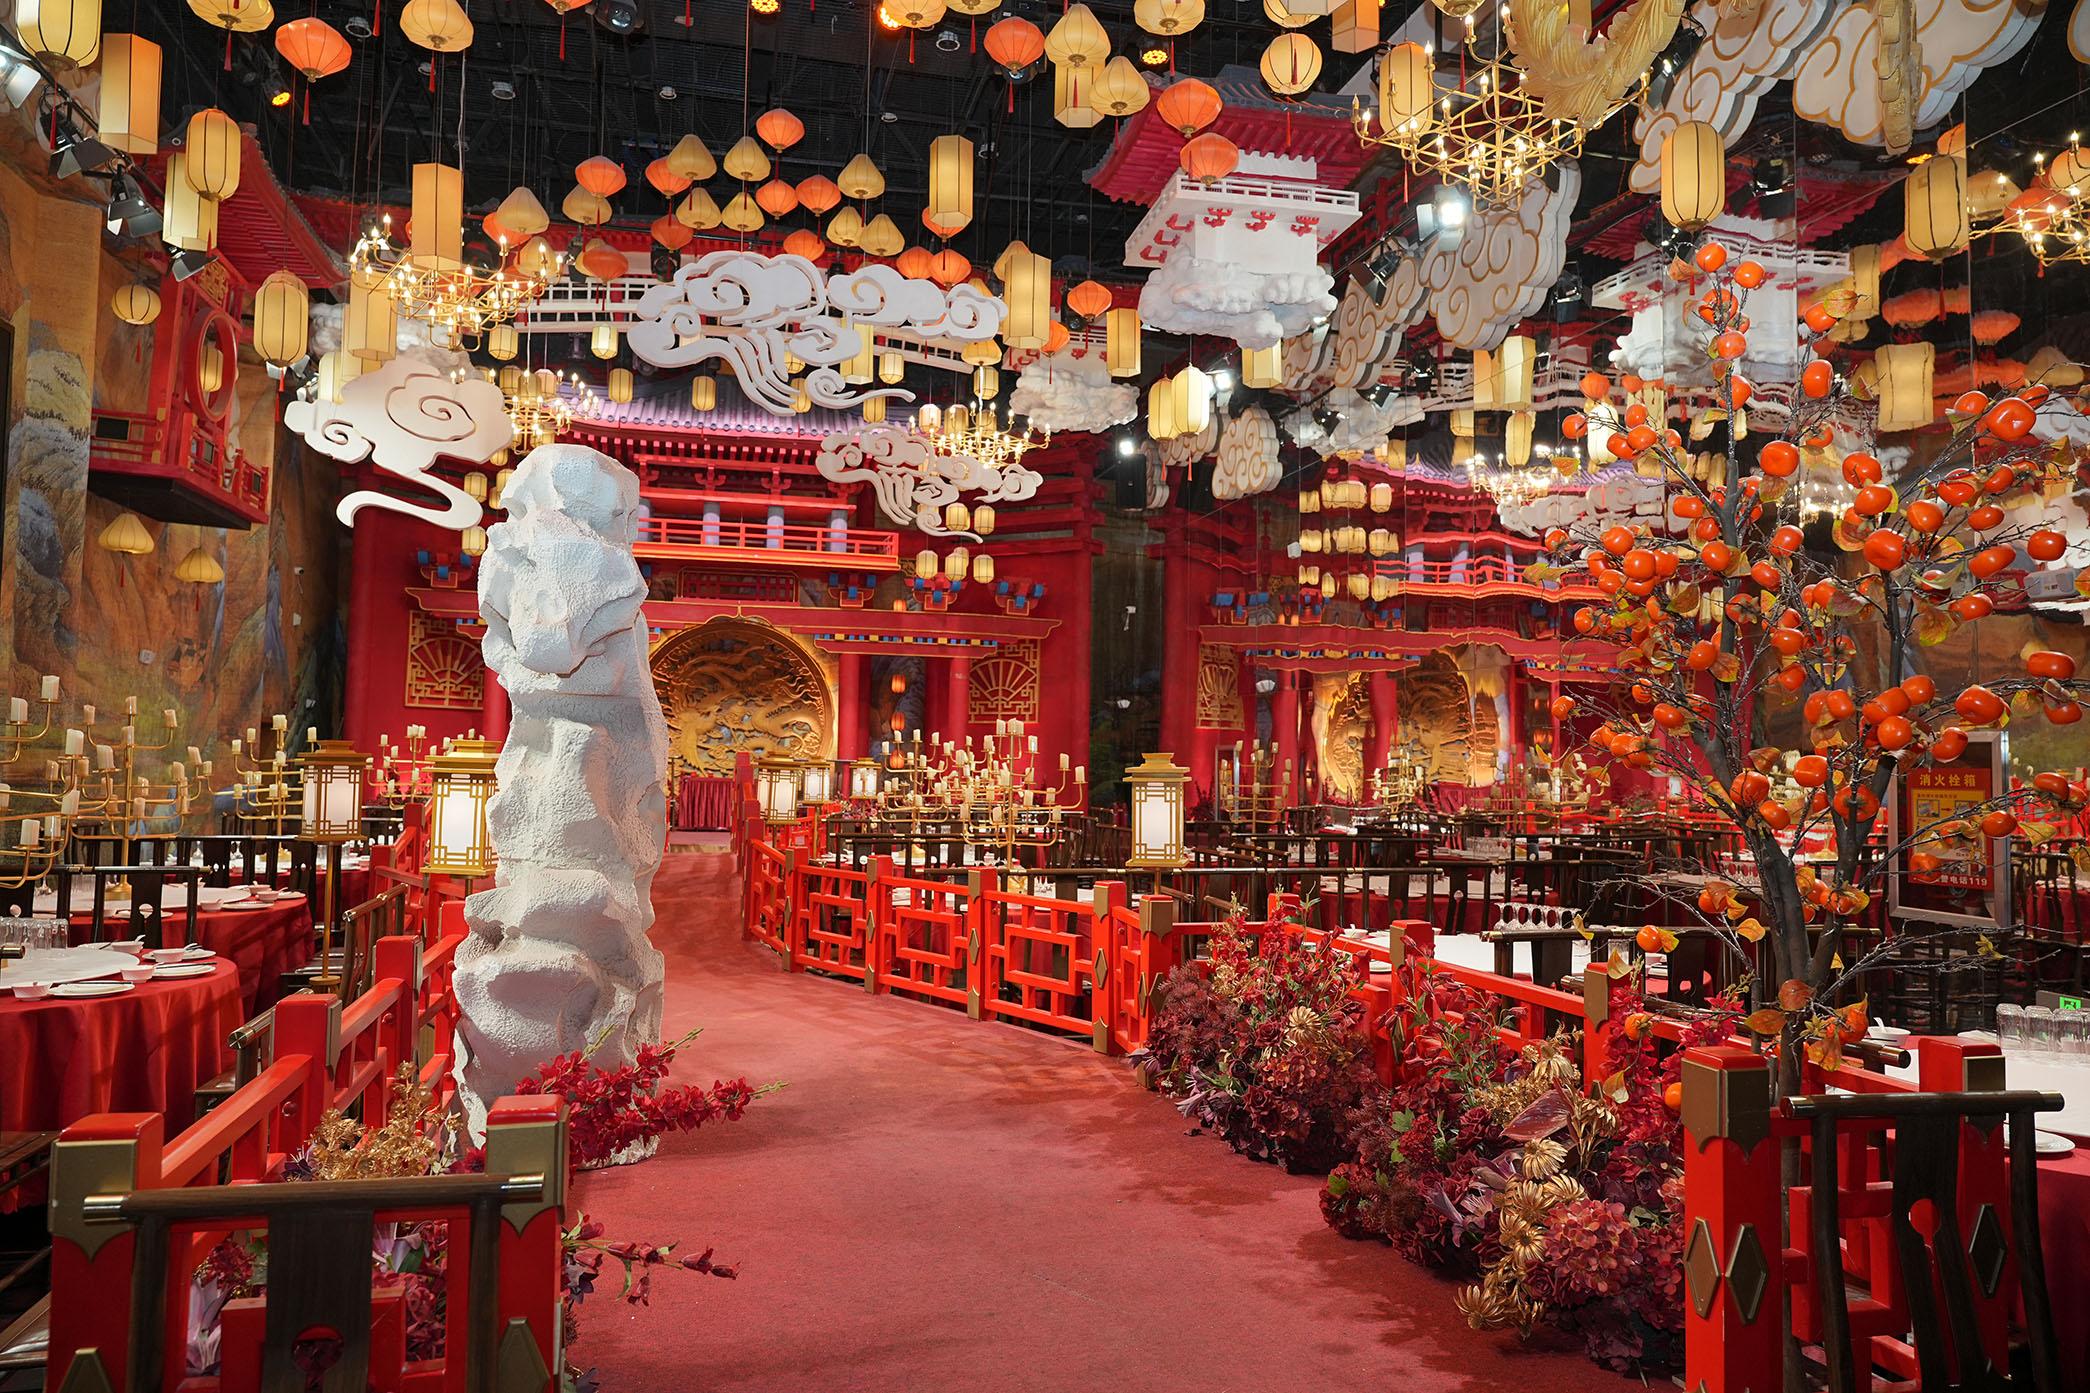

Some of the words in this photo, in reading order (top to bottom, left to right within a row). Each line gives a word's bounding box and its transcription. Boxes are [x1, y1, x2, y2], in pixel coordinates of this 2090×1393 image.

[1920, 774, 1976, 787] 消火栓箱
[1938, 874, 1988, 886] 警电话119
